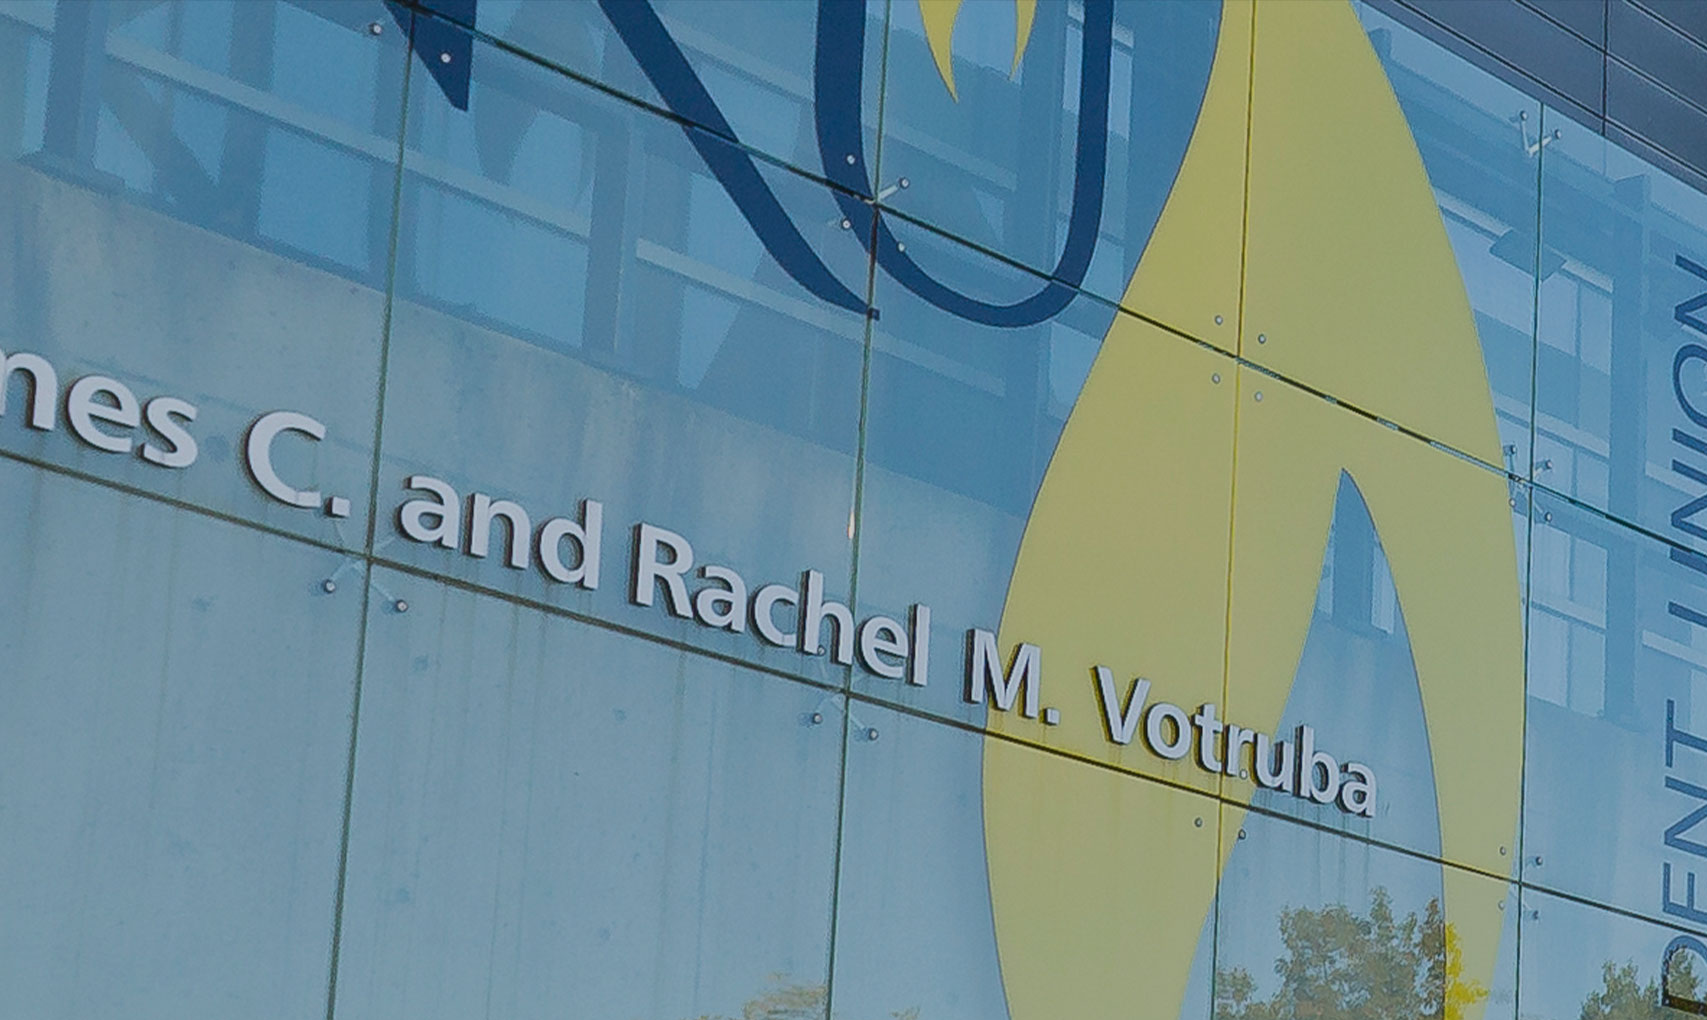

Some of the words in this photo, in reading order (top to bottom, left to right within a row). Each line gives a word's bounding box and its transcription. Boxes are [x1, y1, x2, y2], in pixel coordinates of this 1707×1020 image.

[247, 411, 351, 518] C.
[399, 474, 603, 591] and
[633, 522, 930, 688] Rachel
[964, 627, 1060, 725] M.
[1092, 665, 1378, 819] Votruba
